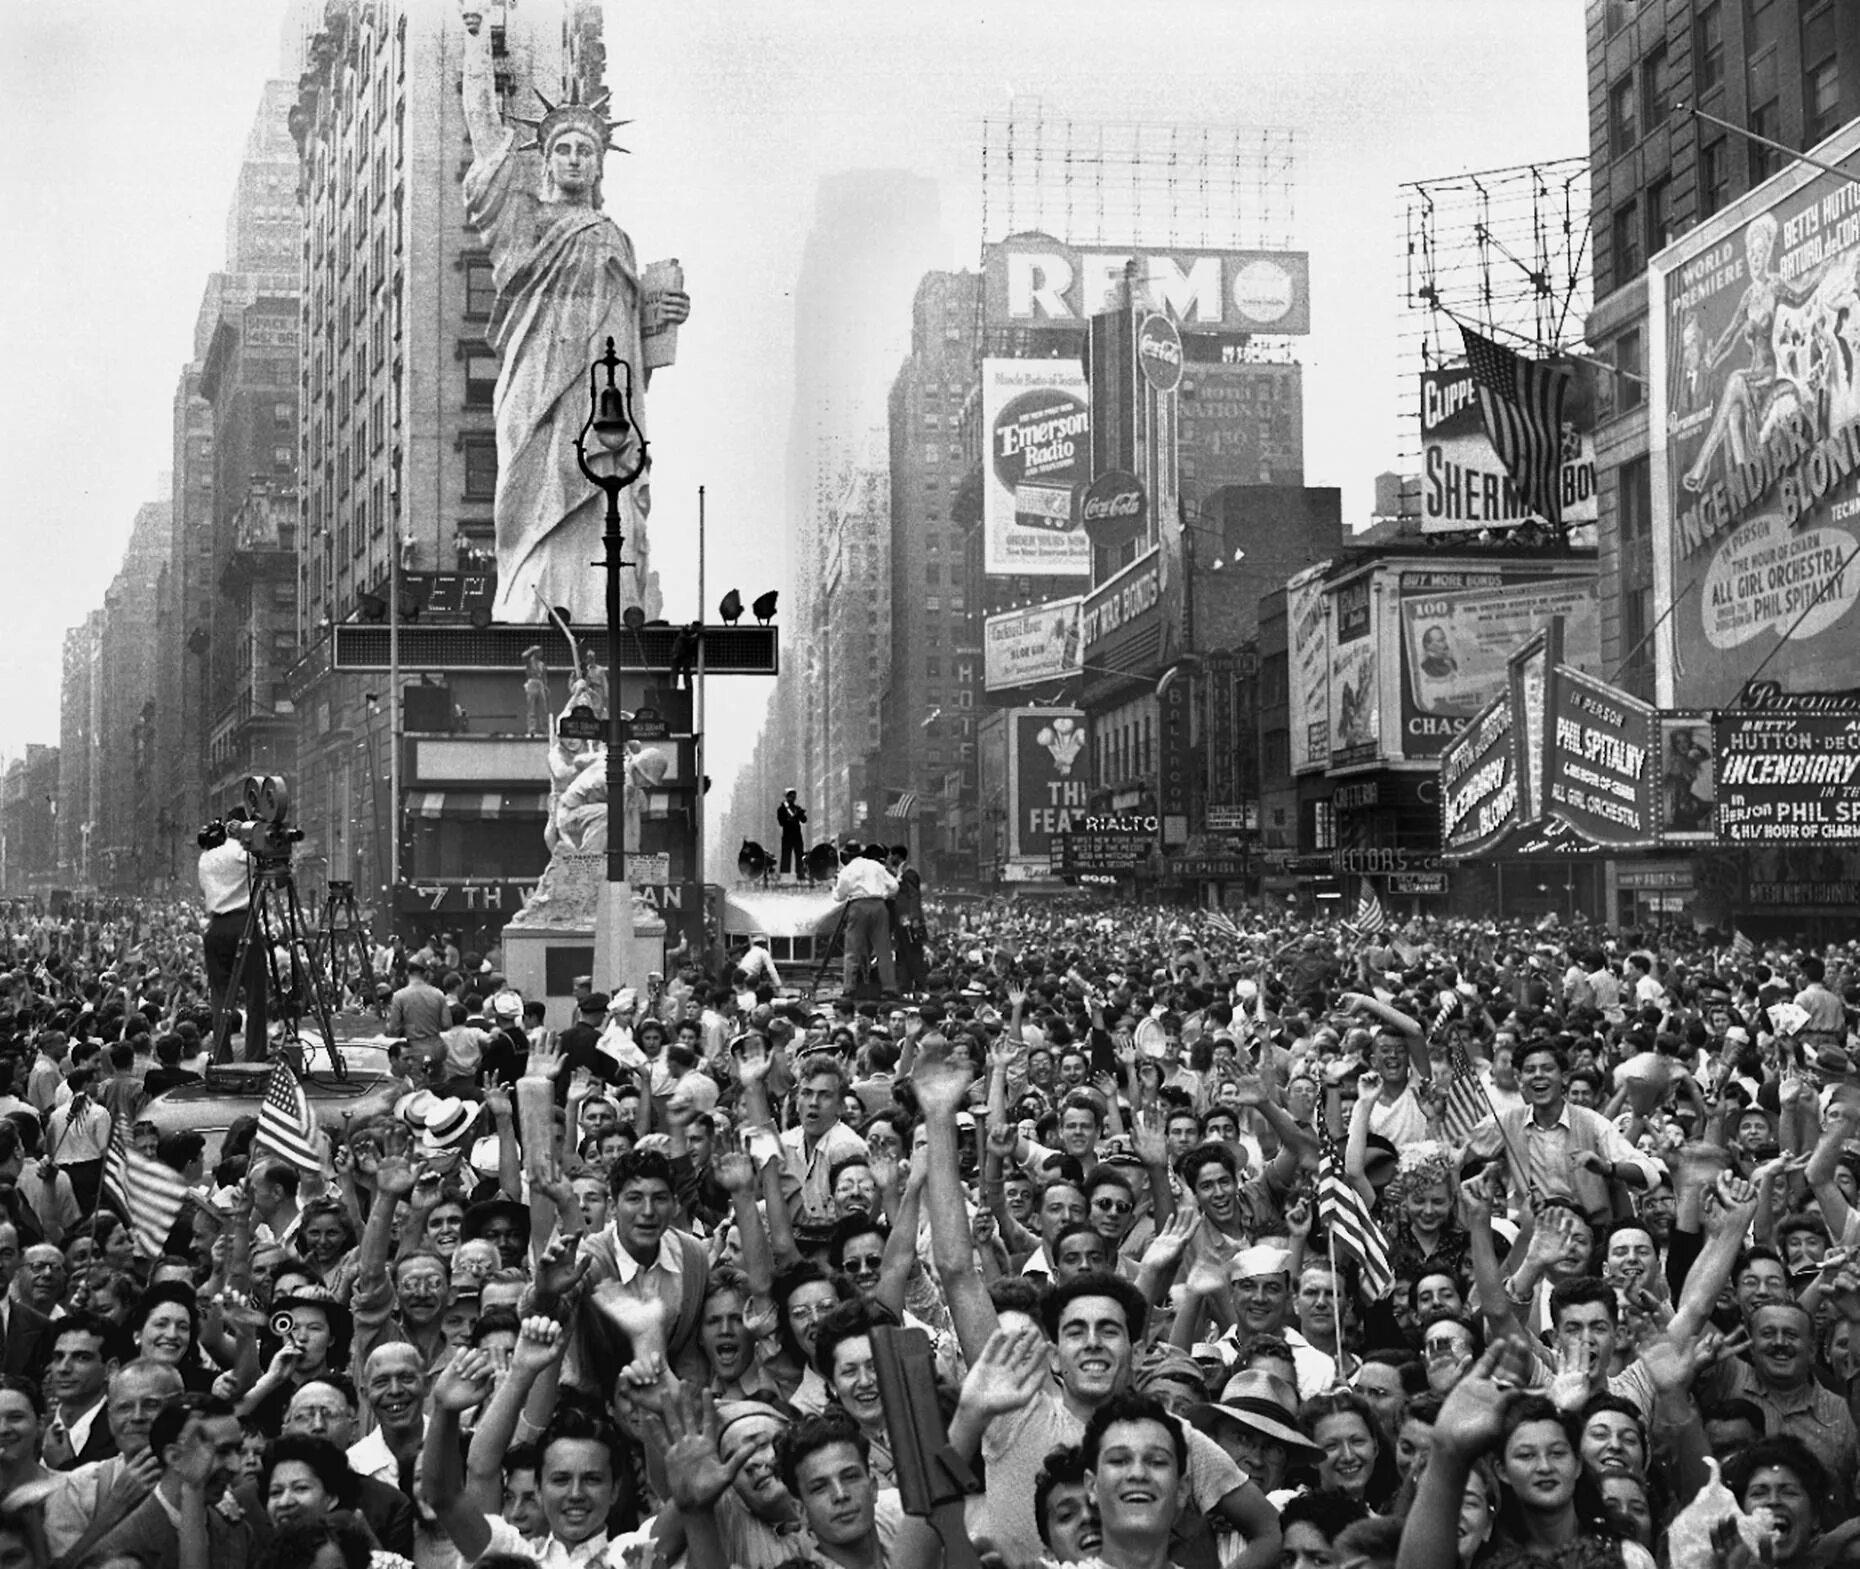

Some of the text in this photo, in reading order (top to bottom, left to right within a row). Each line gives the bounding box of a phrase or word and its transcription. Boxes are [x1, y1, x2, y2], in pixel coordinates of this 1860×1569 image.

[1783, 202, 1819, 250] BETTY
[1683, 242, 1733, 287] WORLD
[1672, 257, 1744, 316] PREMIERE
[996, 411, 1089, 458] Emerson
[1024, 438, 1075, 468] Radio
[1731, 520, 1771, 553] PERSON
[1402, 574, 1503, 588] BUY MORE BONDS
[1711, 545, 1844, 608] ALL GIRL ORCHESTRA
[1415, 601, 1449, 616] 100
[1754, 572, 1845, 622] PHIL SPITALNY
[959, 663, 976, 789] HOTEL
[1569, 690, 1626, 728] IN PERSON
[1556, 715, 1584, 756] PHIL
[1584, 727, 1646, 781] SPITALNY
[1731, 733, 1812, 750] HUTTON
[1825, 736, 1846, 750] DE
[1720, 747, 1860, 784] INCENDIARY
[1819, 786, 1836, 798] IN
[1085, 816, 1159, 831] RIALTO
[1586, 795, 1641, 831] ORCHESTRA
[1777, 802, 1829, 822] PHIL
[1764, 824, 1800, 839] HOUR
[1801, 824, 1819, 838] OF
[461, 886, 501, 910] TH
